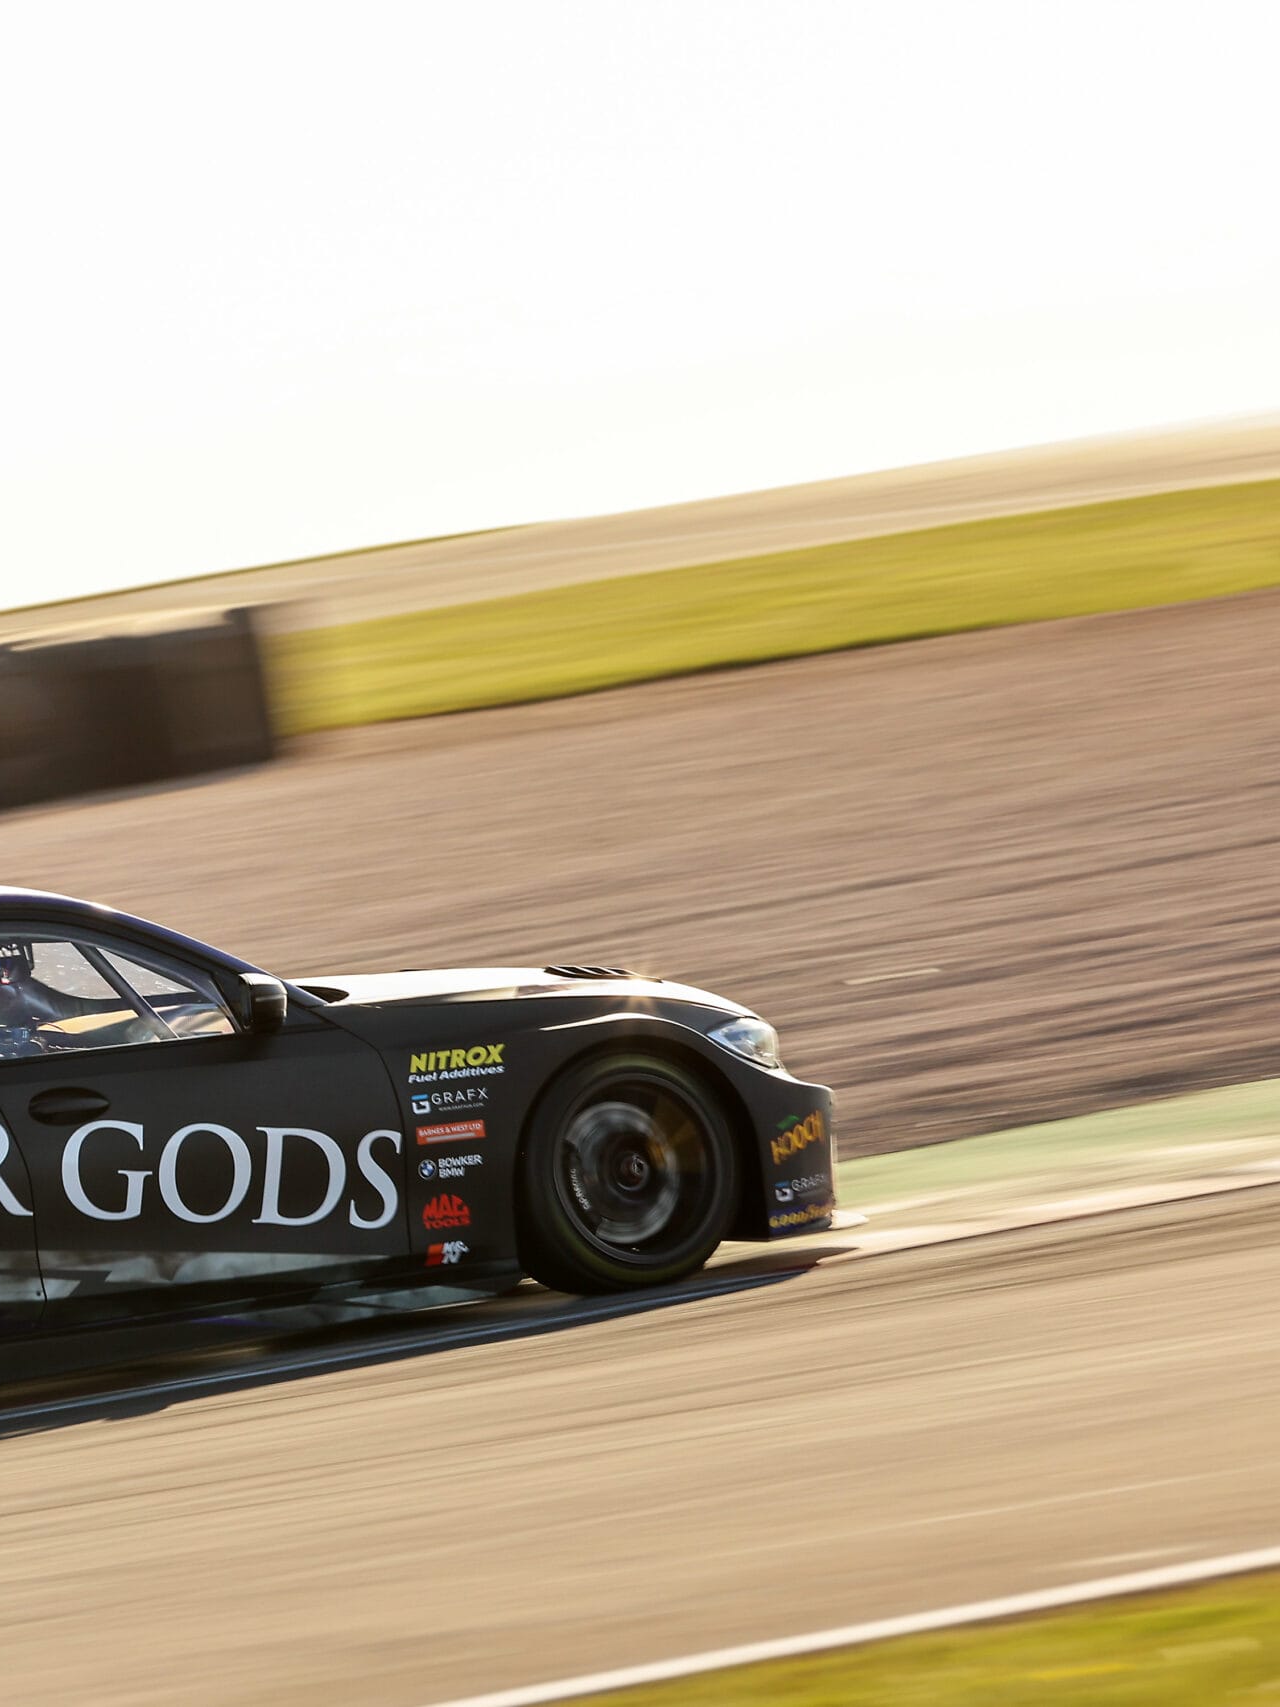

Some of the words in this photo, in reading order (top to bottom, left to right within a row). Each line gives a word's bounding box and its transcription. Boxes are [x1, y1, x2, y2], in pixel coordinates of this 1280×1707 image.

[410, 1044, 505, 1073] NITROX
[408, 1072, 437, 1083] Fuel
[439, 1066, 505, 1079] Additives
[431, 1088, 489, 1105] GRAFX
[438, 1155, 483, 1168] BOWKER
[62, 1120, 402, 1229] GODS
[439, 1167, 465, 1178] BMW
[423, 1193, 469, 1220] MAC
